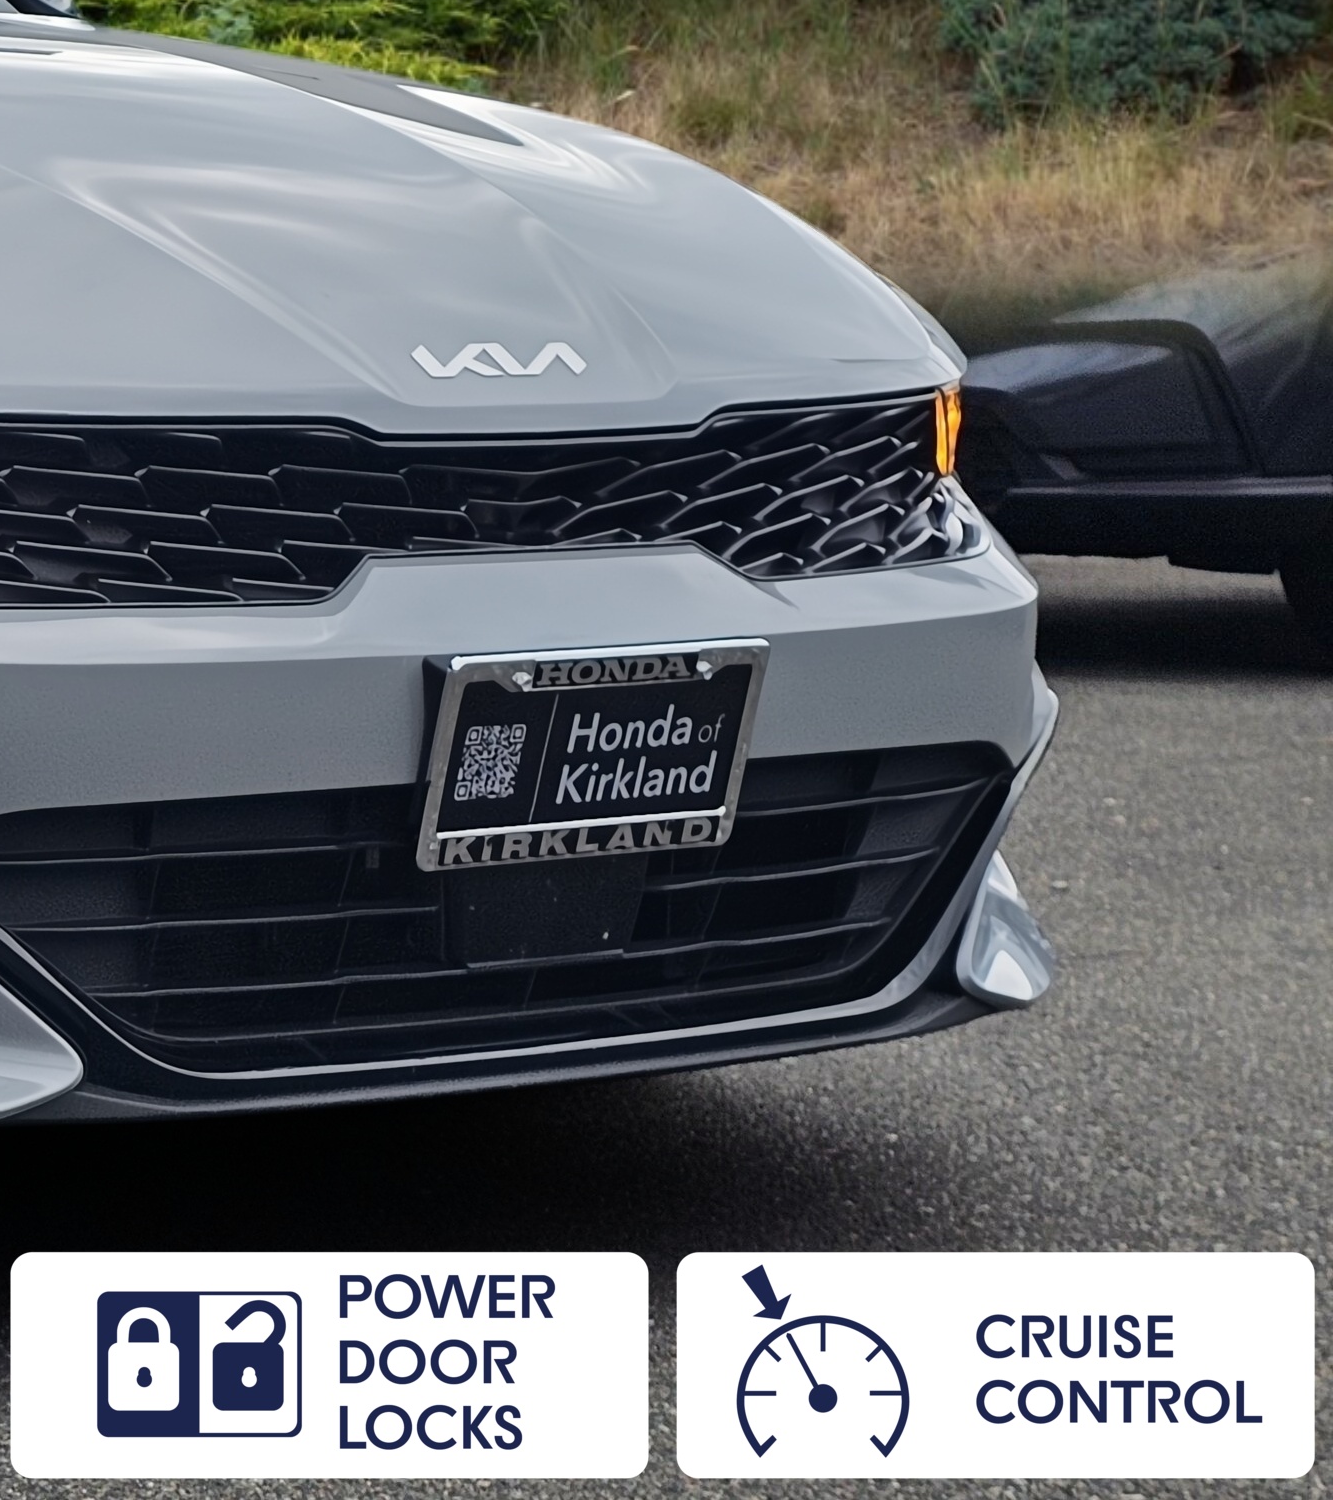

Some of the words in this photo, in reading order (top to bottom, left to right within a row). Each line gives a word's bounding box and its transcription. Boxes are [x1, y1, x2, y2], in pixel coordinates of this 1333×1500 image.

[410, 342, 588, 378] KIA
[536, 655, 691, 687] HONDA
[566, 703, 693, 754] Honda
[698, 712, 727, 744] of
[555, 750, 718, 805] Kirkland
[442, 817, 714, 866] KIRKLAND
